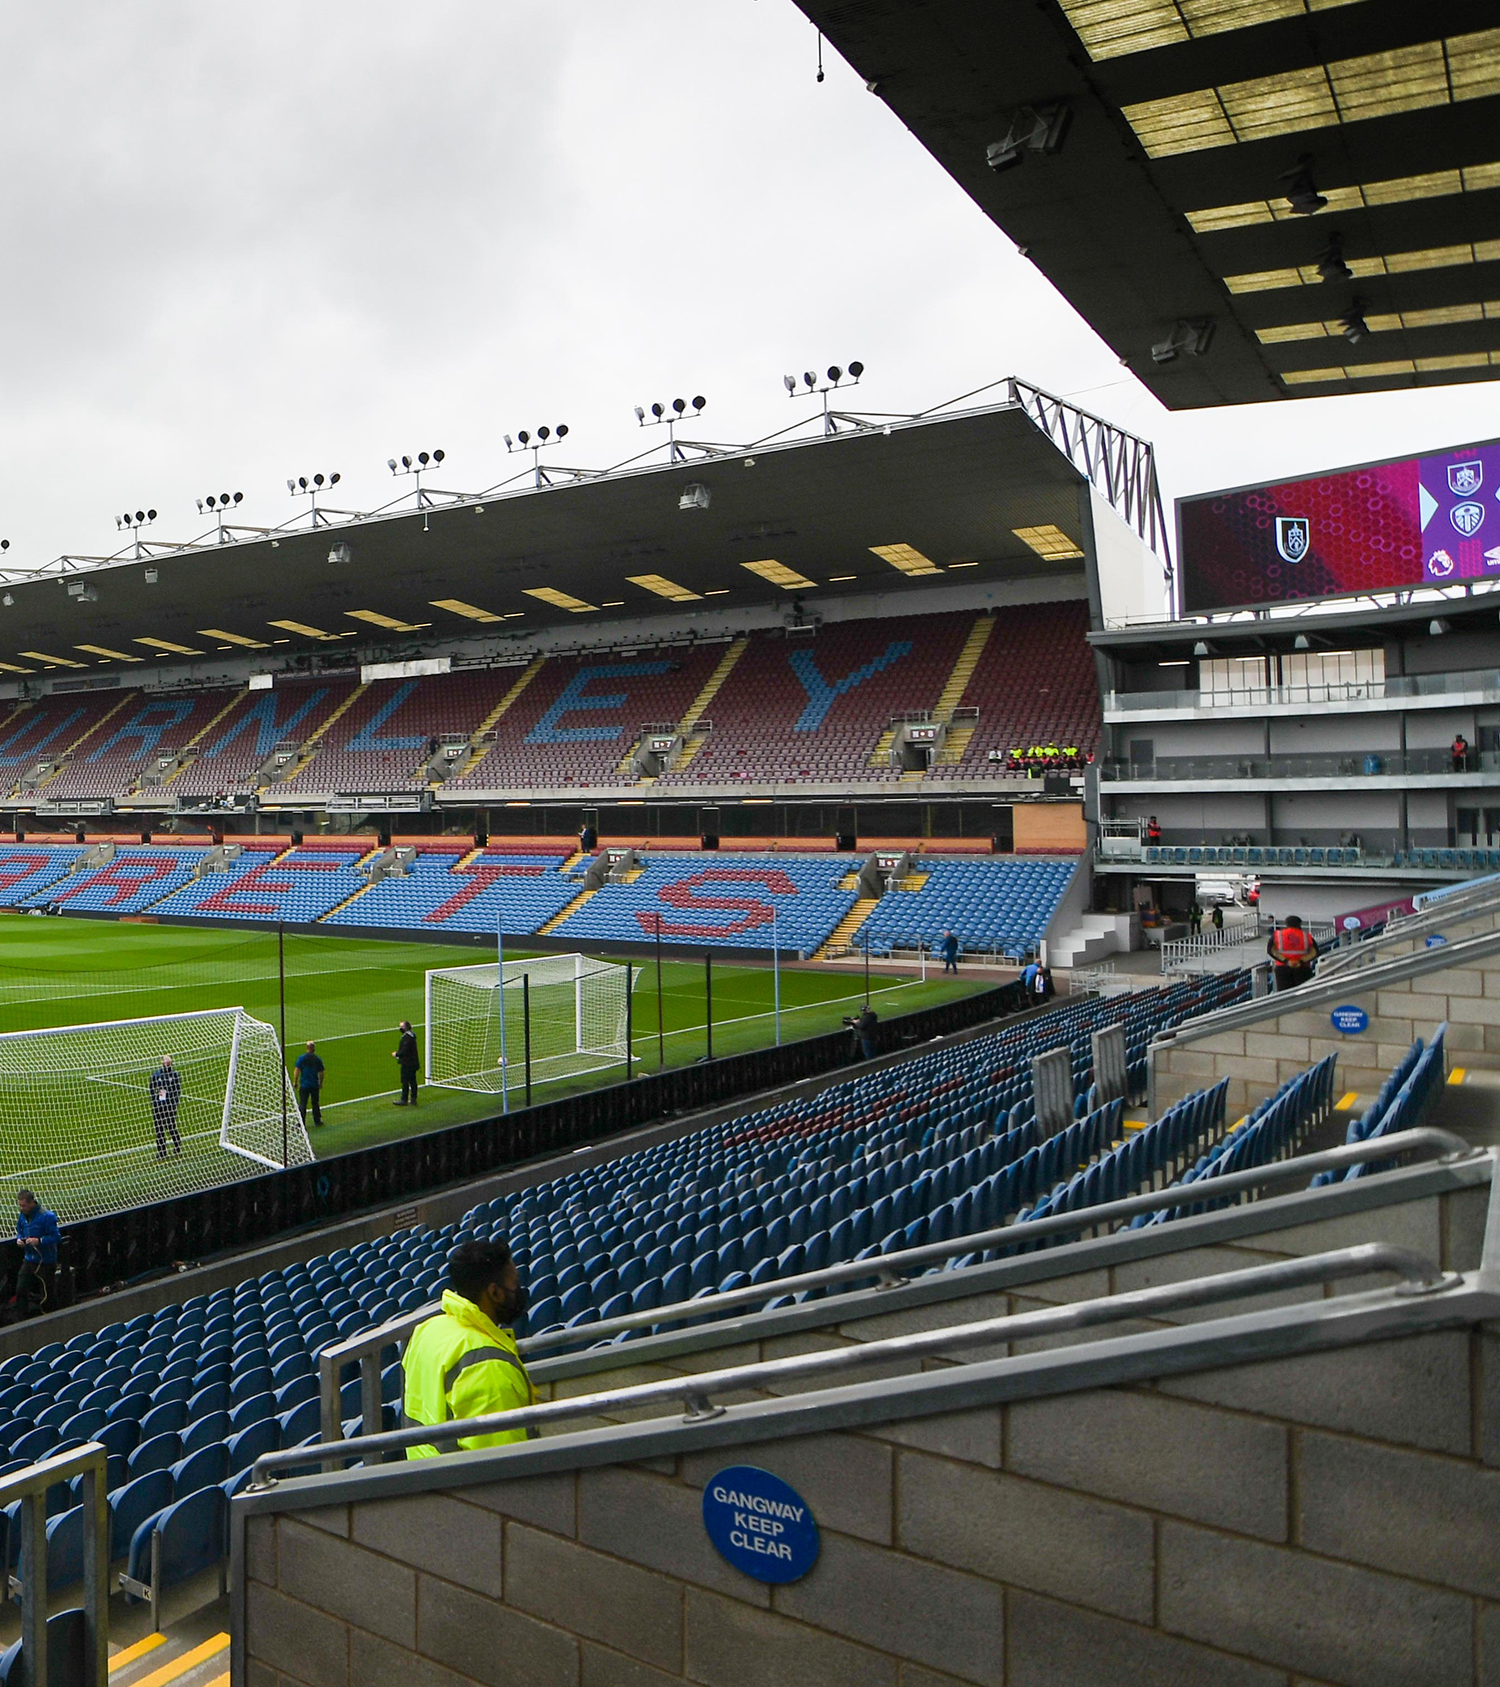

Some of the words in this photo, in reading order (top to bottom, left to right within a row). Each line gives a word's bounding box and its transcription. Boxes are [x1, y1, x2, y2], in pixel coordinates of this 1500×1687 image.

[713, 1486, 804, 1522] GANGWAY
[734, 1511, 784, 1537] KEEP
[730, 1530, 792, 1561] CLEAR
